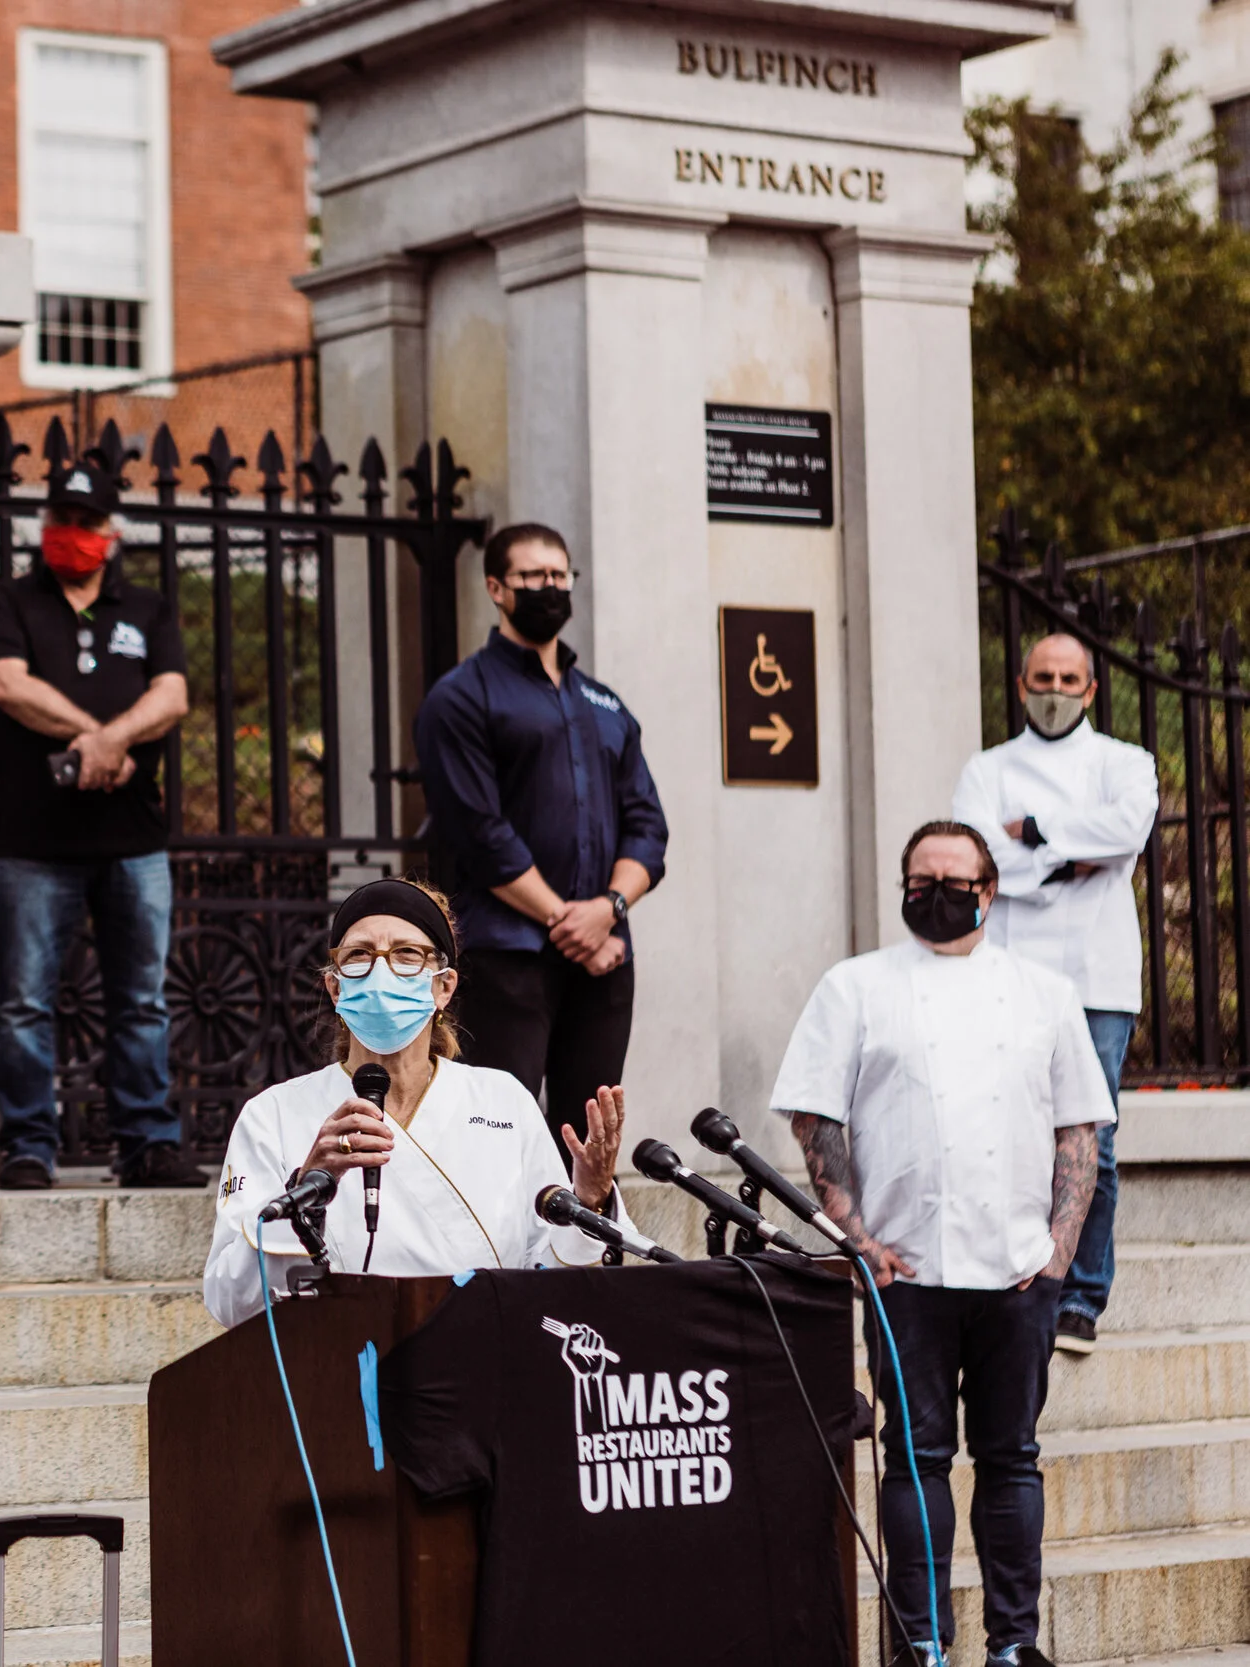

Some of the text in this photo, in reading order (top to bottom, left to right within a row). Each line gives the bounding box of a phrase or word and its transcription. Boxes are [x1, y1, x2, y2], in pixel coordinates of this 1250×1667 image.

[677, 39, 879, 98] BULFINCH
[675, 148, 888, 203] ENTRANCE
[468, 1116, 514, 1130] JODY ADAMS
[219, 1175, 247, 1200] TRADE
[605, 1368, 731, 1427] MASS
[576, 1425, 732, 1463] RESTAURANTS
[578, 1455, 733, 1514] UNITED
